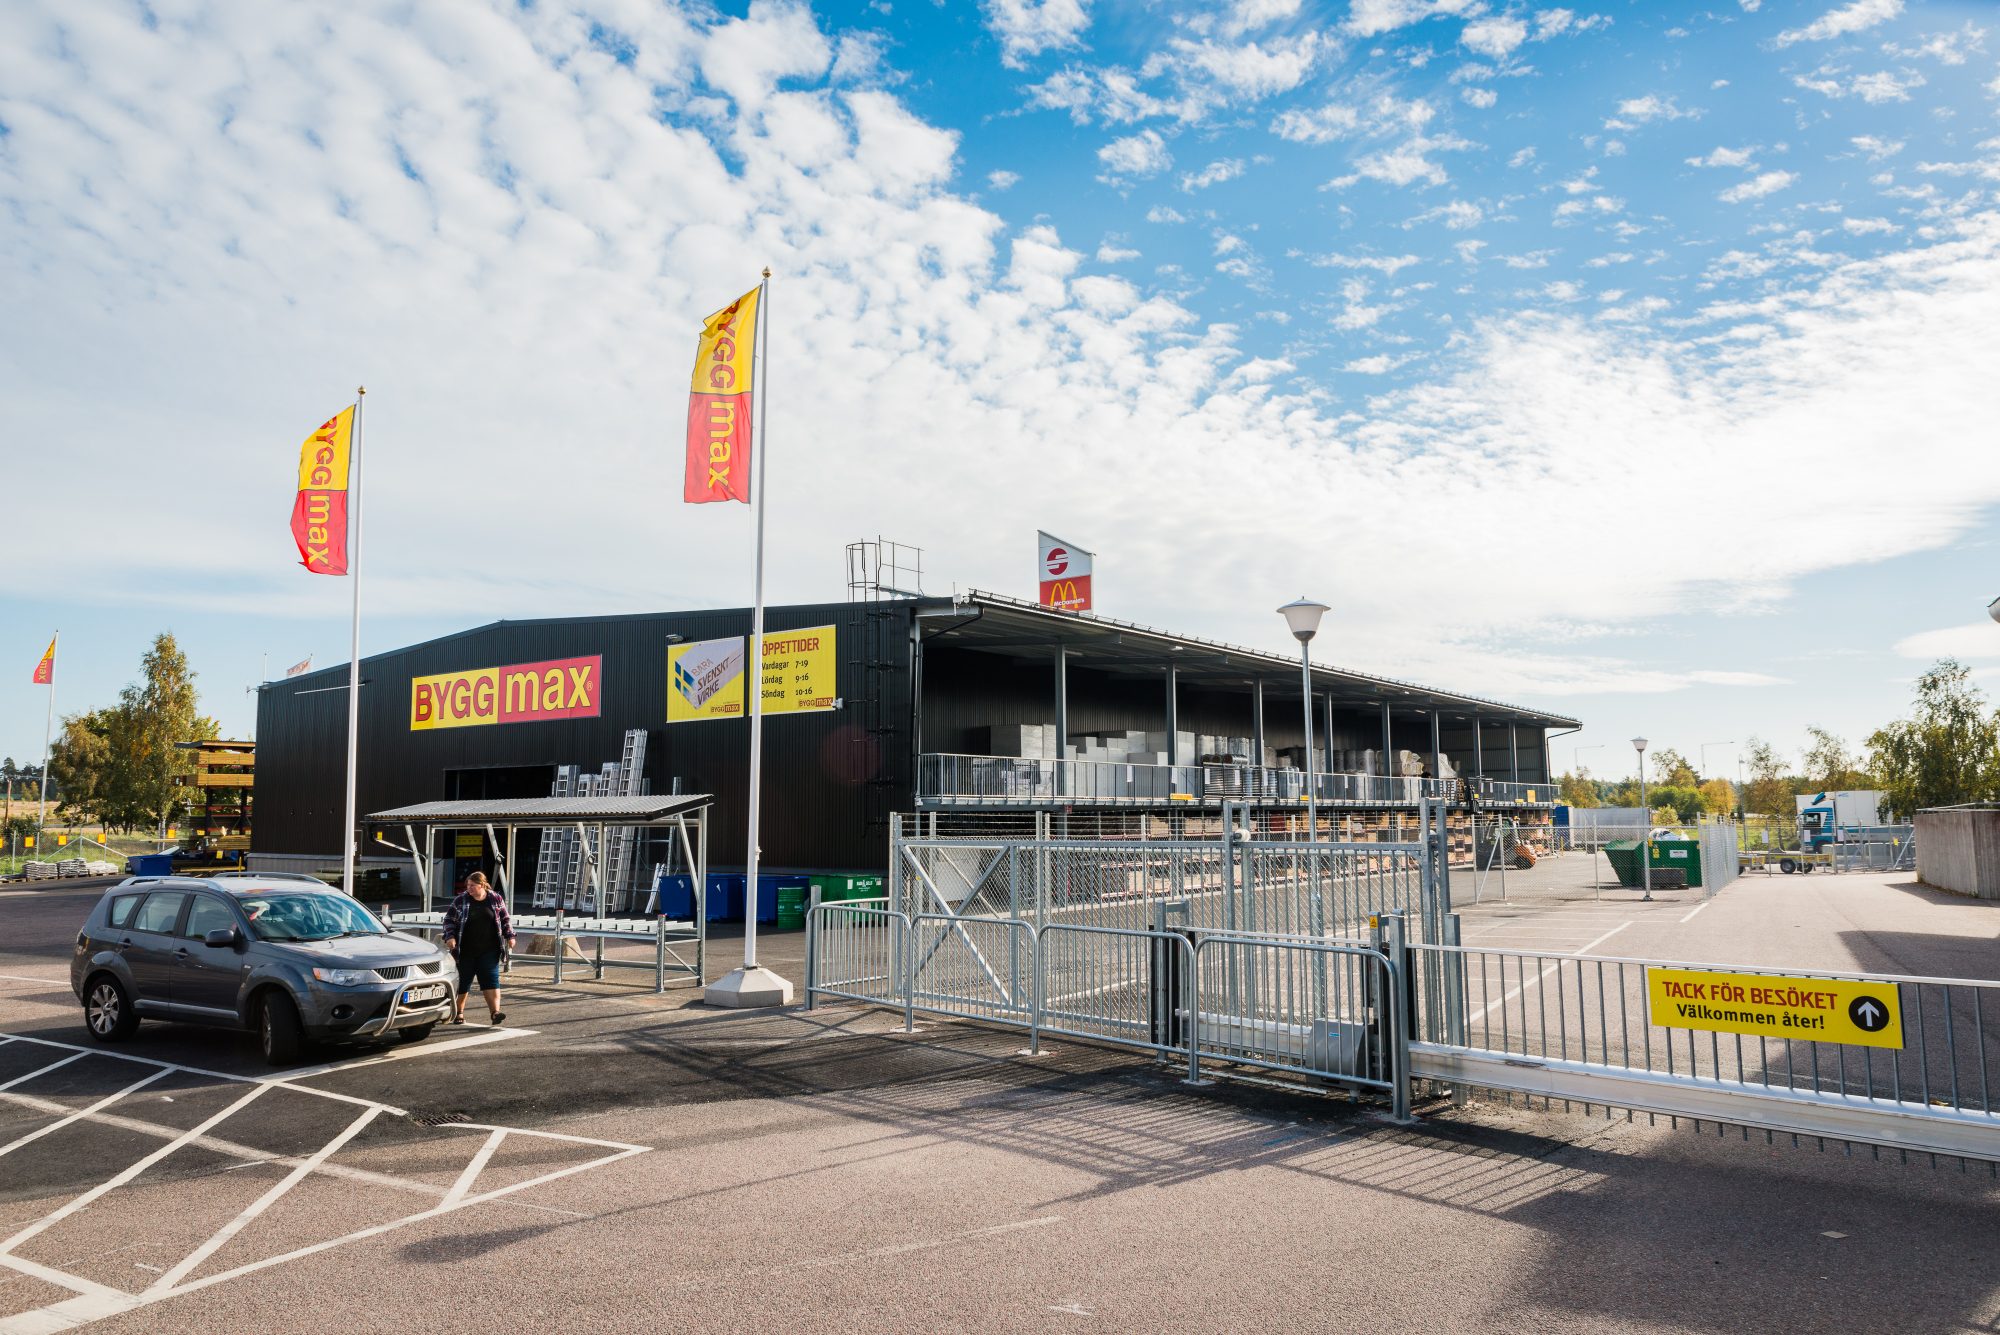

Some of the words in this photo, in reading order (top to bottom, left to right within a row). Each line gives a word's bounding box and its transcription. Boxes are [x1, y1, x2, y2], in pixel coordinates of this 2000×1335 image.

[762, 638, 820, 656] ÖPPETTIDER
[691, 658, 714, 677] BARA
[697, 657, 730, 691] SVENSKT
[762, 661, 789, 670] Vardagar
[795, 660, 809, 669] 7-19
[761, 675, 783, 685] Lördag
[795, 673, 809, 683] 9-16
[697, 679, 720, 706] VIRKE
[761, 690, 785, 699] Söndag
[795, 687, 813, 696] 10-16
[1662, 981, 1707, 1000] TACK
[1711, 982, 1746, 1003] FÖR
[1750, 987, 1838, 1010] BESÖKET
[1676, 1003, 1776, 1026] Välkommen
[1782, 1011, 1826, 1030] åter!
